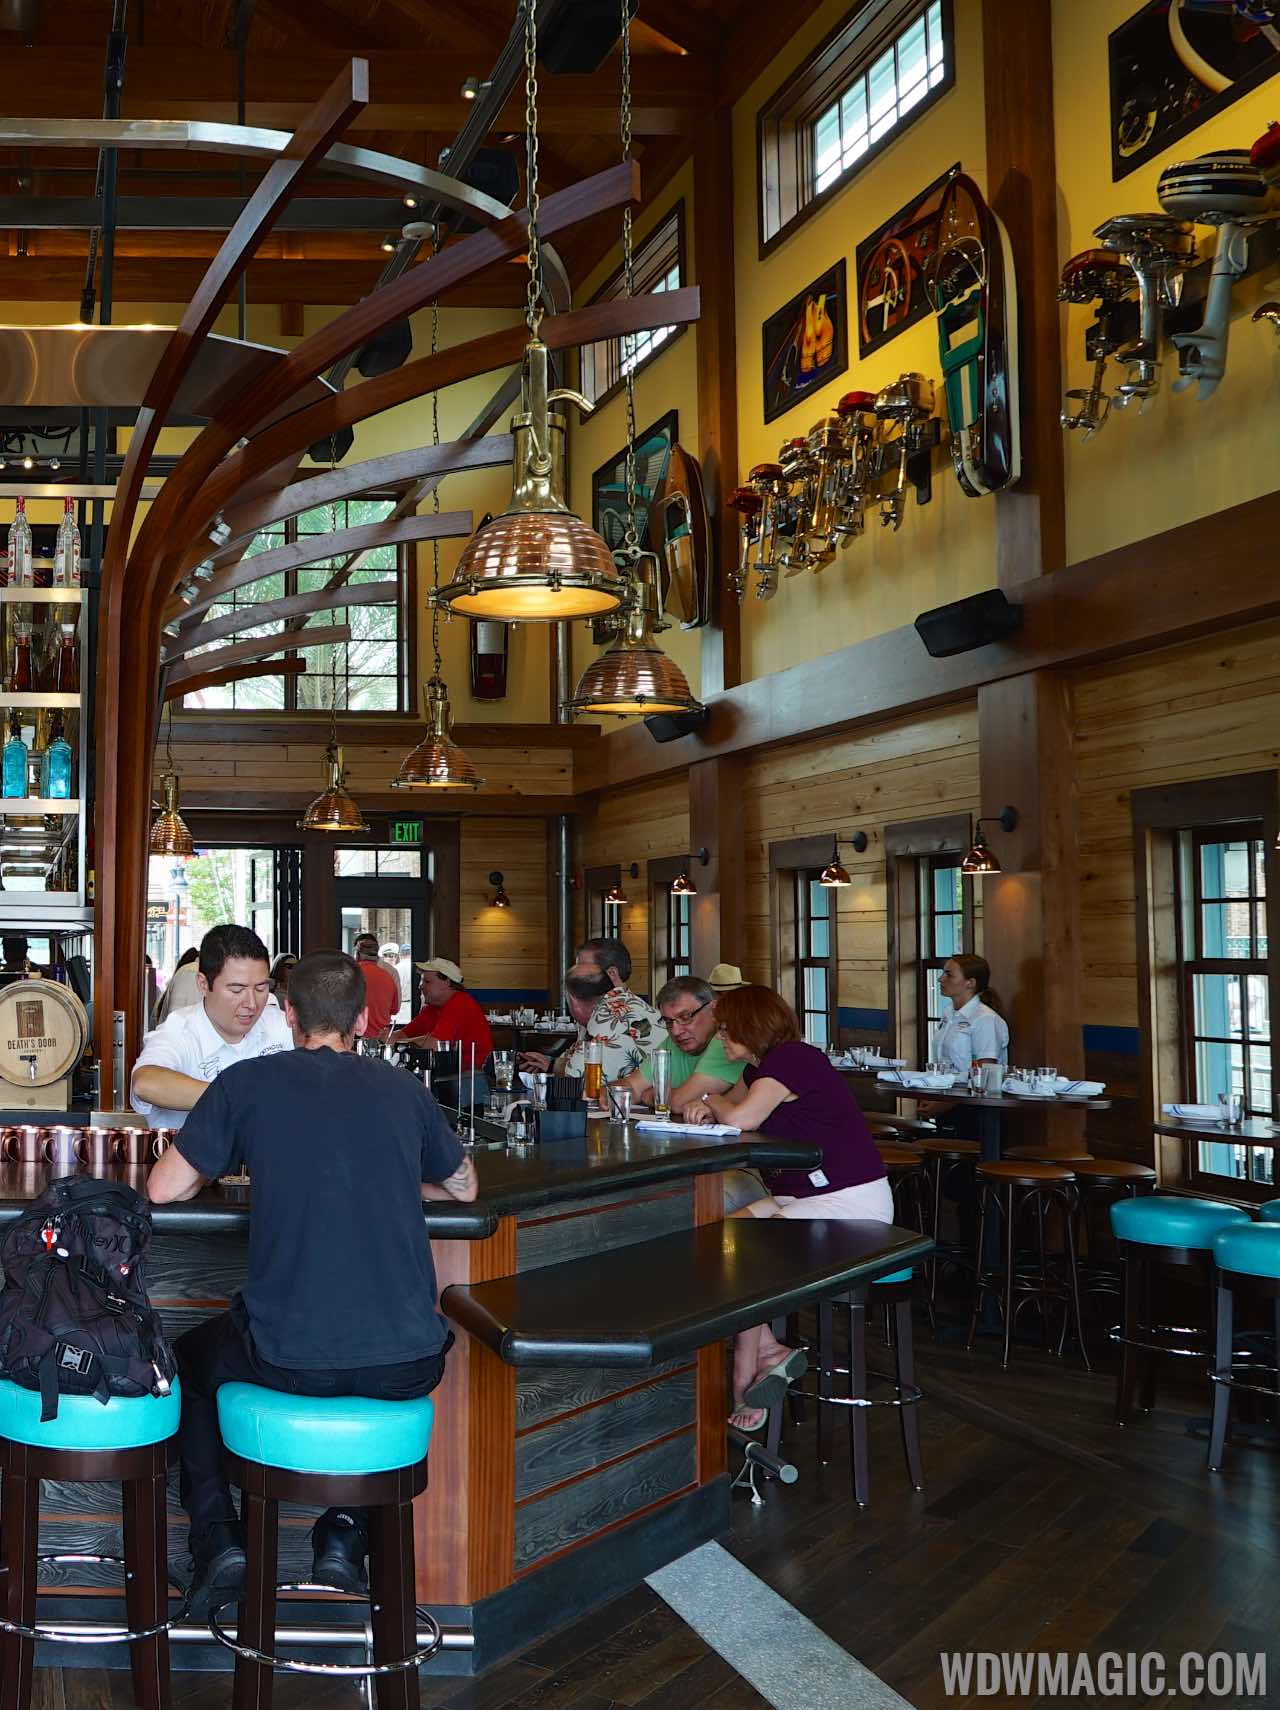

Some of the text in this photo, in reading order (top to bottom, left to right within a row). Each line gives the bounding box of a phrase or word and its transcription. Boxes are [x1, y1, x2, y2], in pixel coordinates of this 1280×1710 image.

[395, 822, 420, 841] EXIT
[7, 1037, 57, 1050] DEATH'S DOOR
